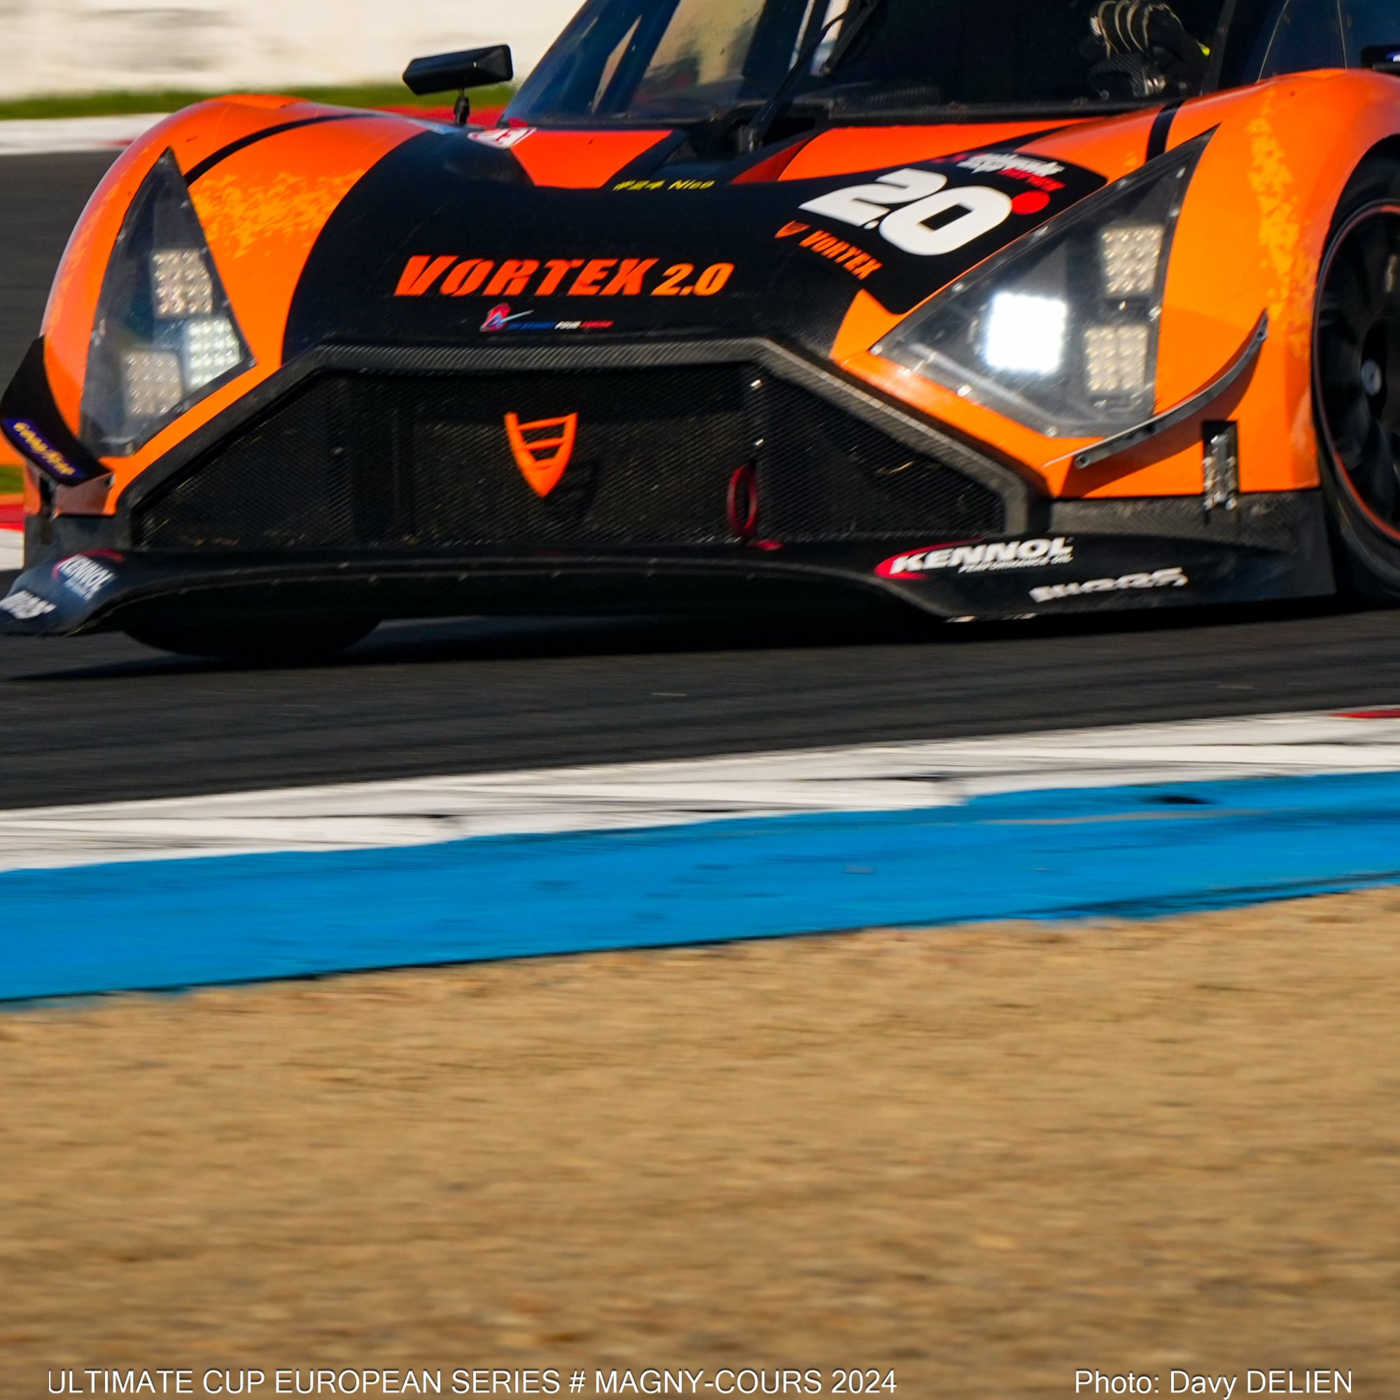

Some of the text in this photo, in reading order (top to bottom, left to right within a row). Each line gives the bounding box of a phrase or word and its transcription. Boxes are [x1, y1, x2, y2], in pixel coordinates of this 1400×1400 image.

[394, 255, 736, 297] VORTEX 2.0
[800, 229, 884, 281] VORTEX
[890, 537, 1074, 575] KENNOL
